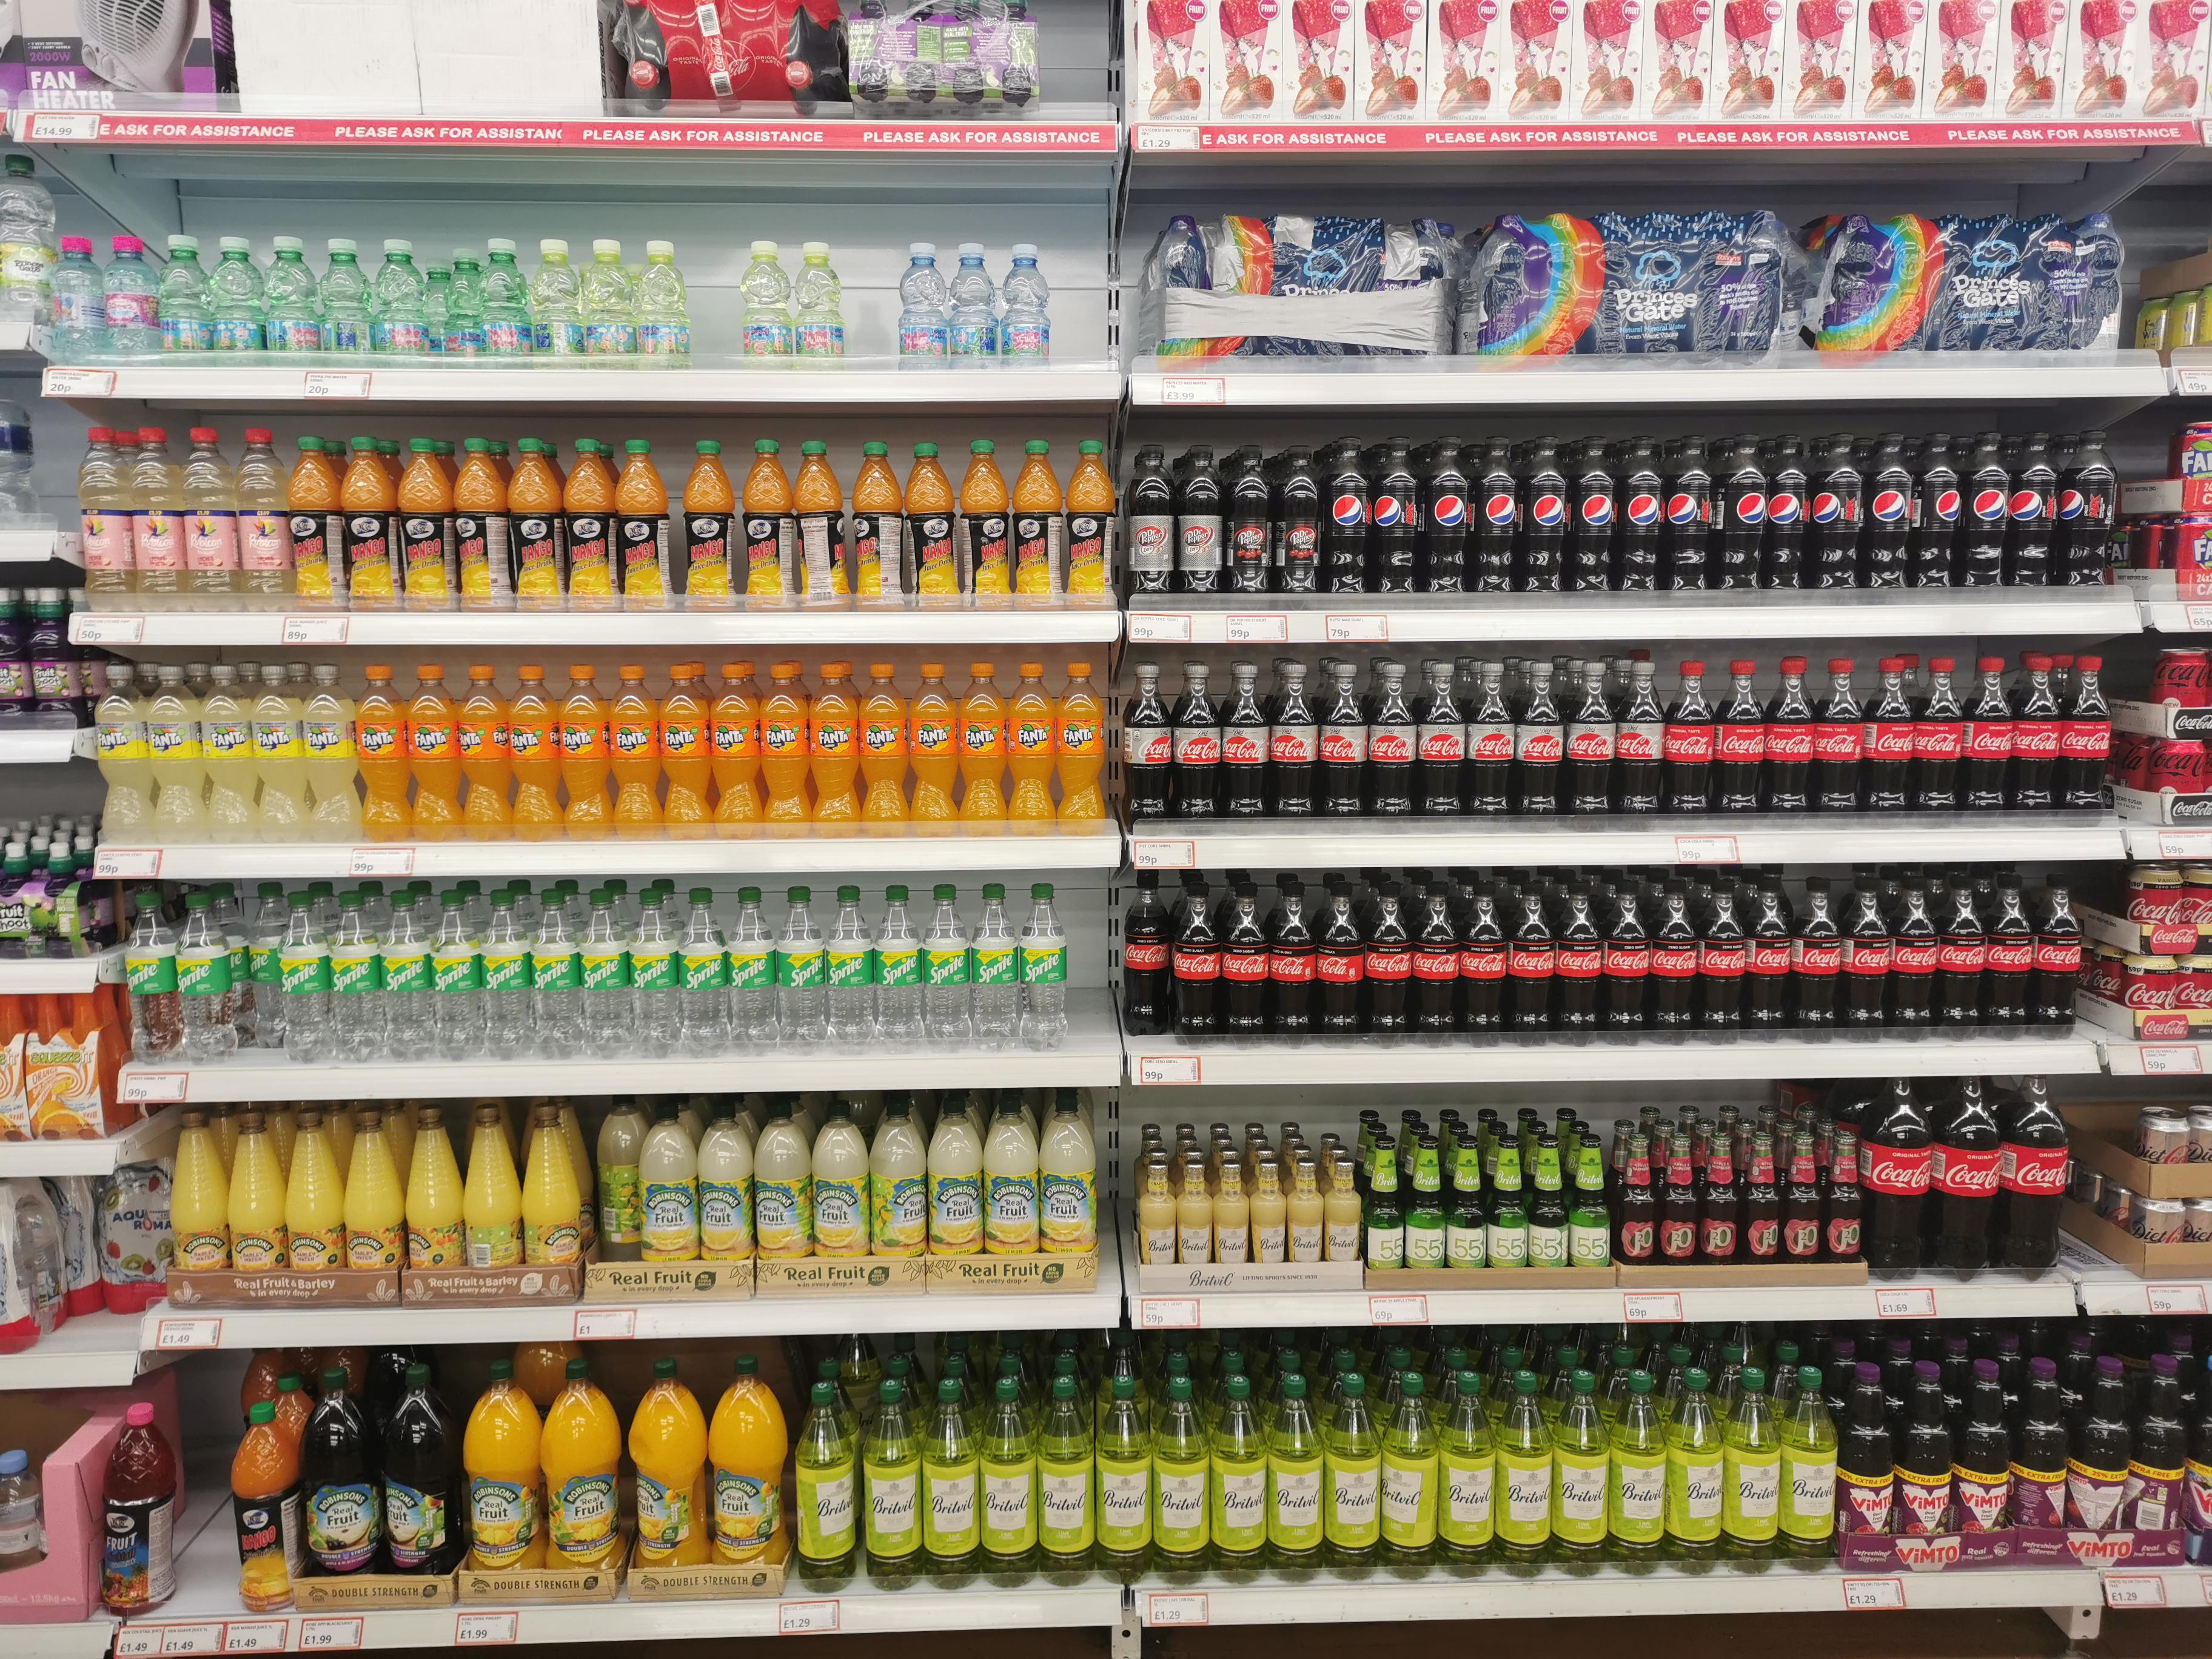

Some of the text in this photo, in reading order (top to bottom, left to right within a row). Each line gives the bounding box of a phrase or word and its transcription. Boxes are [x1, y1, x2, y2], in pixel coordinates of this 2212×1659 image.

[29, 52, 71, 62] 2000W
[31, 71, 76, 90] FAN
[33, 90, 116, 110] HEATER
[35, 127, 72, 136] £14.99
[114, 124, 148, 136] ASK
[153, 125, 187, 136] FOR
[190, 125, 295, 138] ASSISTANCE
[335, 126, 397, 138] PLEASE
[401, 127, 435, 139] ASK
[439, 127, 473, 139] FOR
[583, 130, 823, 143] PLEASE ASK FOR ASSISTANCE
[1678, 130, 1910, 142] PLEASE ASK FOR ASSISTANCE
[1948, 127, 2181, 141] PLEASE ASK FOR ASSISTANCE
[863, 132, 1101, 144] PLEASE ASK FOR ASSISTANCE
[1216, 133, 1249, 144] ASK
[1253, 133, 1285, 144] FOR
[1289, 133, 1387, 144] ASSISTANCE
[1426, 131, 1658, 143] PLEASE ASK FOR ASSISTANCE
[1142, 139, 1170, 148] £1.29
[1951, 274, 2030, 296] Princes
[1613, 288, 1698, 311] Princes
[1963, 290, 2020, 308] Gate
[1625, 303, 1684, 323] Gate
[50, 383, 71, 393] 20p
[308, 386, 329, 395] 20p
[2188, 383, 2207, 392] 49p
[2090, 493, 2101, 518] MAX
[1138, 532, 1164, 545] Pepper
[1145, 529, 1157, 538] Dr
[1247, 530, 1259, 539] Dr
[1239, 534, 1264, 545] Pepper
[691, 538, 724, 561] MANGO
[922, 537, 951, 562] MANGO
[691, 557, 723, 571] Juice Drink
[923, 557, 951, 572] Juice Drink
[2193, 618, 2212, 627] 65p
[81, 631, 101, 640] 50p
[287, 631, 307, 640] 89p
[1134, 628, 1153, 637] 99p
[1230, 629, 1250, 638] 99p
[1330, 629, 1350, 638] 79p
[917, 729, 948, 742] FANTA
[1437, 726, 1450, 735] Diet
[211, 730, 246, 745] FANTA
[361, 731, 394, 745] FANTA
[2062, 731, 2110, 749] Coca-Cola
[1419, 737, 1465, 757] Coca-Cola
[1765, 734, 1811, 753] Coca-Cola
[1682, 851, 1701, 860] 99p
[2165, 846, 2184, 856] 59p
[1139, 856, 1158, 865] 99p
[98, 865, 118, 874] 99p
[354, 863, 374, 873] 99p
[2153, 927, 2193, 944] Coca-Cola
[1367, 952, 1411, 971] Coca-Cola
[883, 954, 917, 986] Sprite
[1025, 953, 1059, 984] Sprite
[387, 960, 424, 992] Sprite
[2148, 1061, 2166, 1070] 59p
[1145, 1071, 1163, 1081] 99p
[128, 1088, 147, 1098] 99p
[993, 1184, 1034, 1201] ROBINSONS
[999, 1206, 1027, 1217] Fruit
[2133, 1219, 2167, 1244] Diet
[1454, 1238, 1482, 1258] 55
[959, 1262, 1039, 1278] Real Fruit
[234, 1279, 261, 1290] Real
[263, 1278, 290, 1289] Fruit
[298, 1278, 335, 1290] Barley
[292, 1289, 310, 1299] drop
[2153, 1301, 2171, 1310] 59p
[1145, 1313, 1164, 1323] 59p
[1375, 1311, 1392, 1320] 69p
[1629, 1309, 1647, 1318] 69p
[579, 1326, 590, 1335] £1
[163, 1335, 190, 1344] £1.49
[1909, 1475, 1948, 1485] EXTRA FREE
[473, 1486, 517, 1504] ROBINSONS
[484, 1500, 503, 1509] Real
[479, 1506, 508, 1520] Fruit
[106, 1533, 138, 1548] FRUIT
[494, 1579, 580, 1590] DOUBLE STRENGTH
[1849, 1595, 1876, 1604] £1.29
[2112, 1592, 2137, 1601] £1.29
[1155, 1611, 1180, 1620] £1.29
[783, 1618, 810, 1628] £1.29
[304, 1635, 332, 1644] £1.99
[460, 1630, 488, 1639] £1.99
[119, 1643, 147, 1652] £1.49
[166, 1641, 193, 1651] £1.49
[229, 1638, 256, 1648] £1.49
